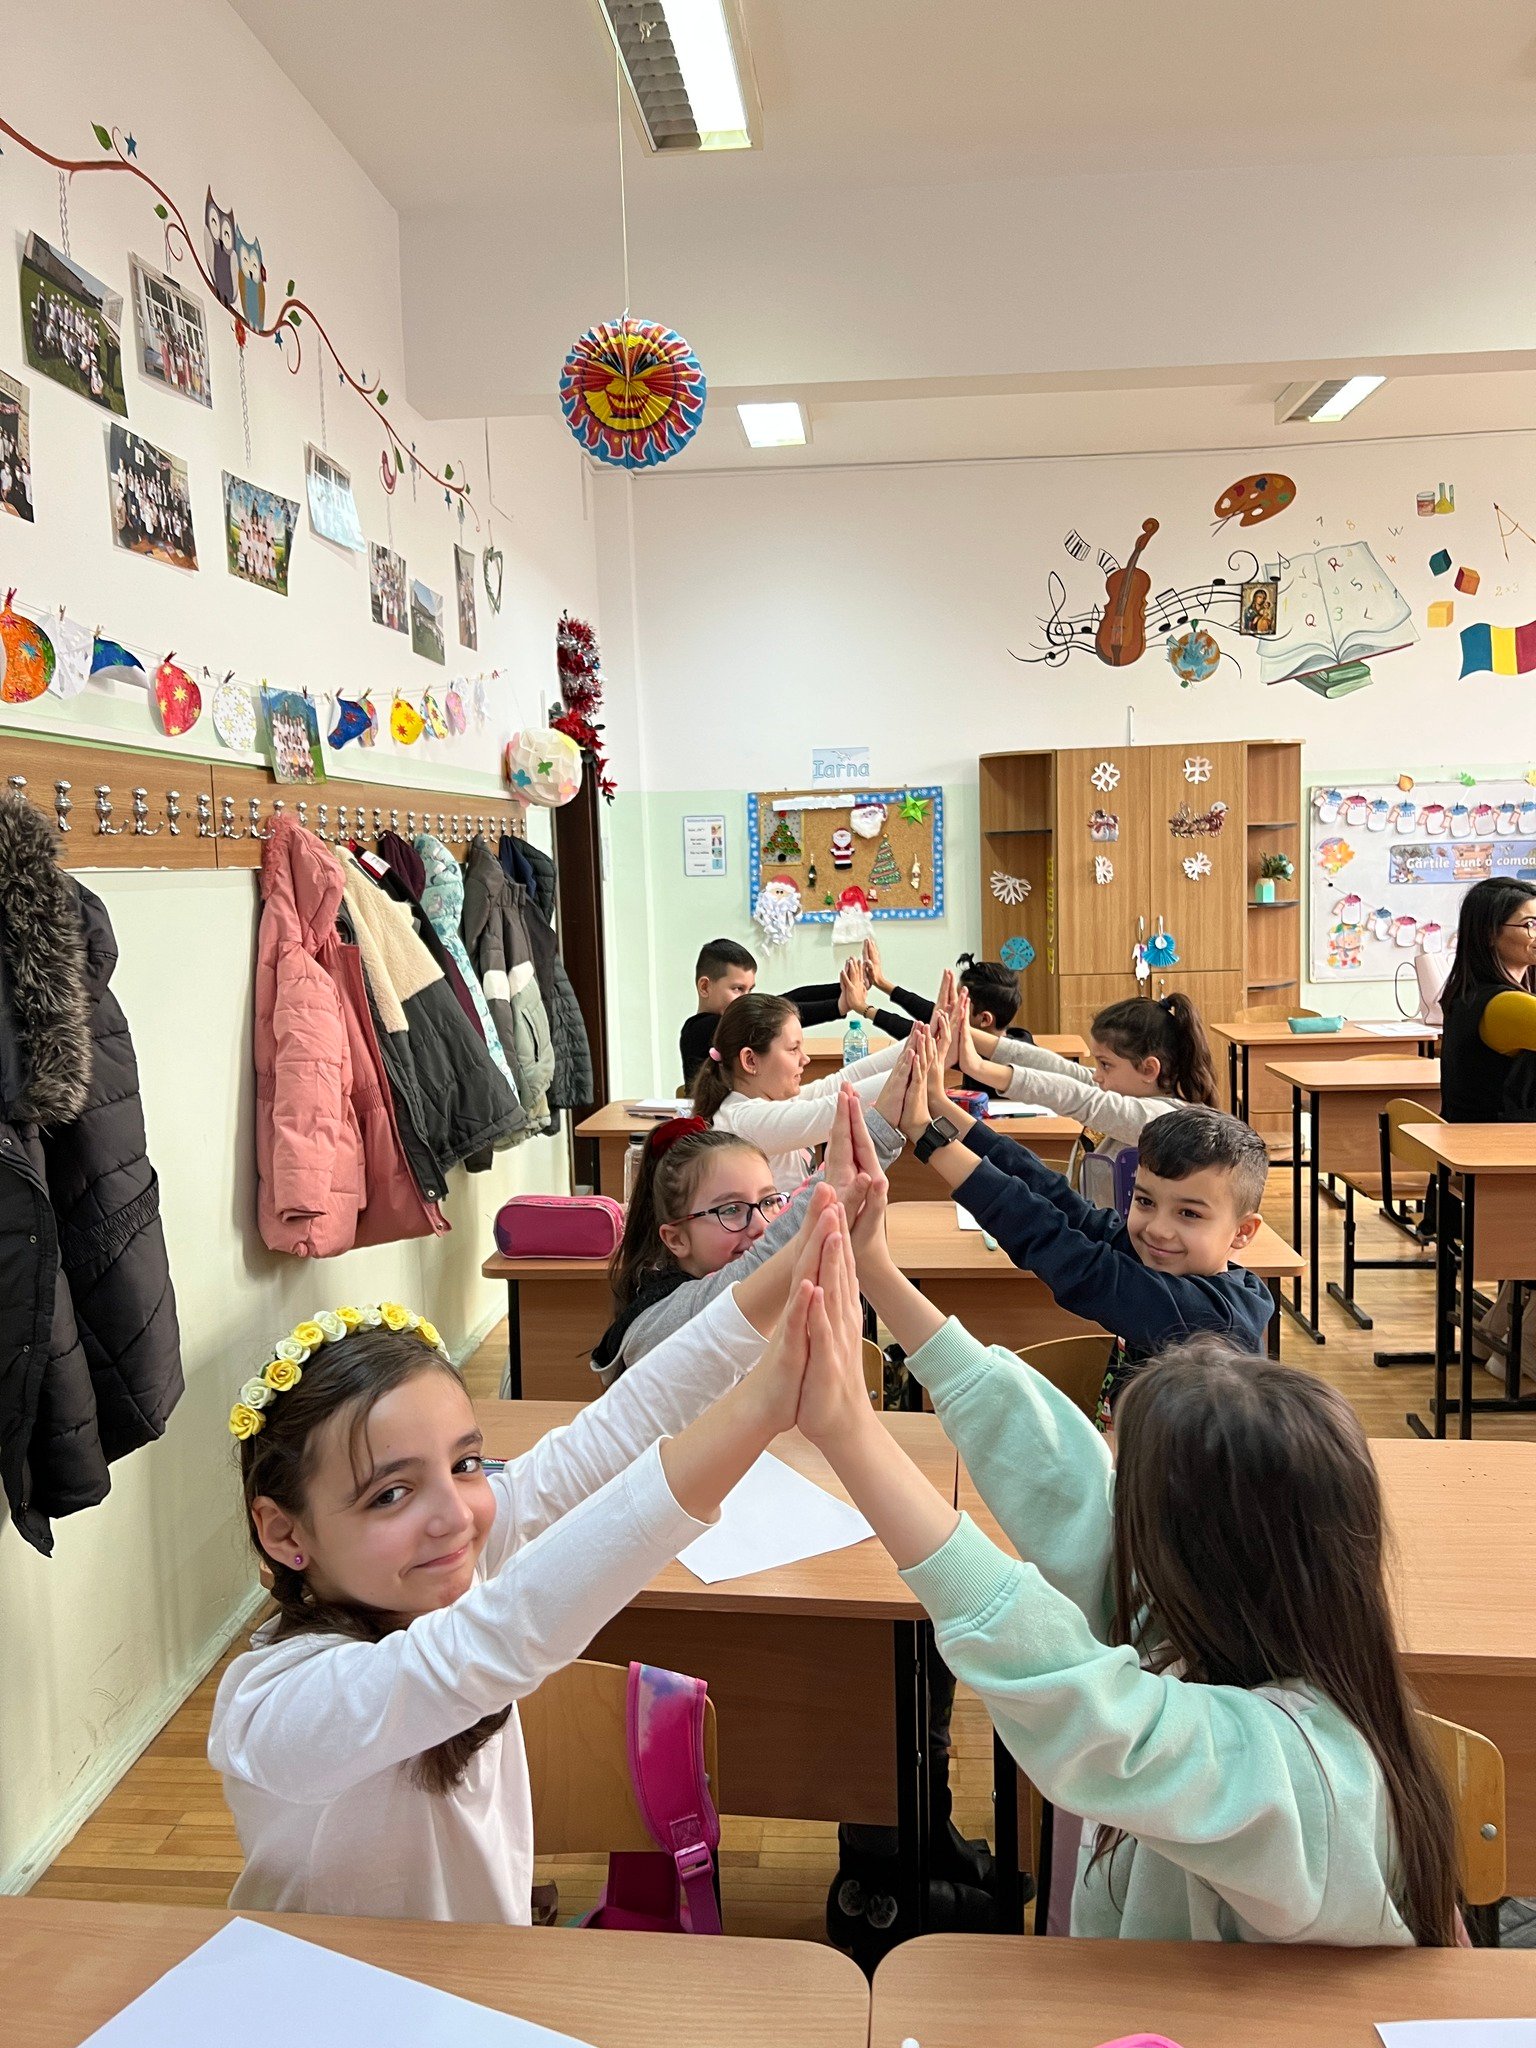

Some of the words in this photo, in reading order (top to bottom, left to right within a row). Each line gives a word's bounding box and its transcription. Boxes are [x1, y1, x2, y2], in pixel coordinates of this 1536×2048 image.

[1388, 526, 1403, 536] W
[1327, 557, 1343, 572] R
[1350, 577, 1363, 591] 5
[1305, 613, 1316, 627] Q
[1334, 607, 1343, 621] 3
[1364, 608, 1373, 620] L
[812, 760, 870, 778] Iarna
[1455, 857, 1481, 868] sunt
[1496, 856, 1536, 866] comoa
